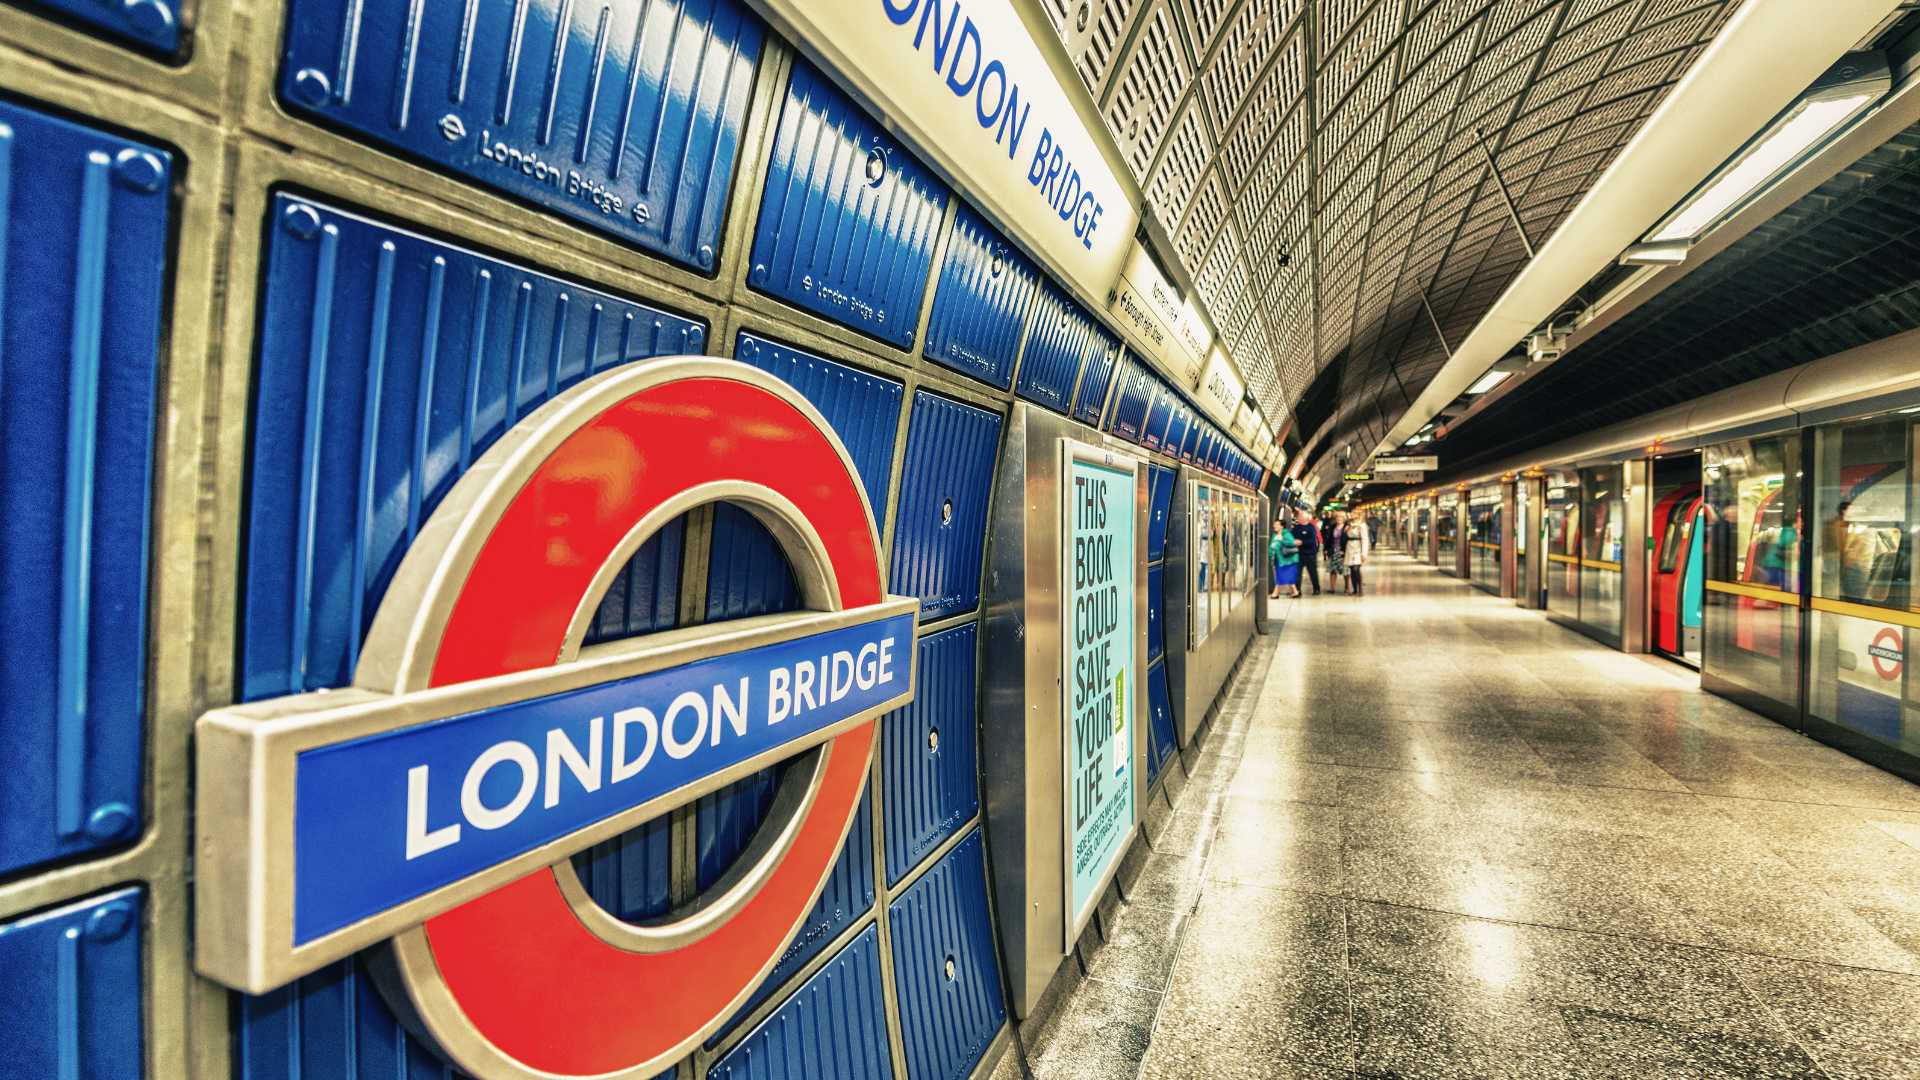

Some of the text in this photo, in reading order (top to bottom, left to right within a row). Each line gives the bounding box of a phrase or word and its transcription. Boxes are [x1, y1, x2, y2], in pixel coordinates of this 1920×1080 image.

[882, 0, 1103, 251] NDON BRIDGE
[480, 129, 624, 214] London Bridge
[818, 281, 848, 307] London
[1125, 295, 1144, 328] Borough
[1075, 476, 1107, 530] THIS
[1075, 534, 1113, 591] BOOK
[1075, 585, 1118, 650] COULD
[1075, 639, 1111, 711] SAVE
[405, 636, 896, 861] LONDON BRIDGE
[1075, 691, 1112, 770] YOUR
[1076, 753, 1104, 832] LIFE
[1087, 810, 1105, 841] EFFECTS
